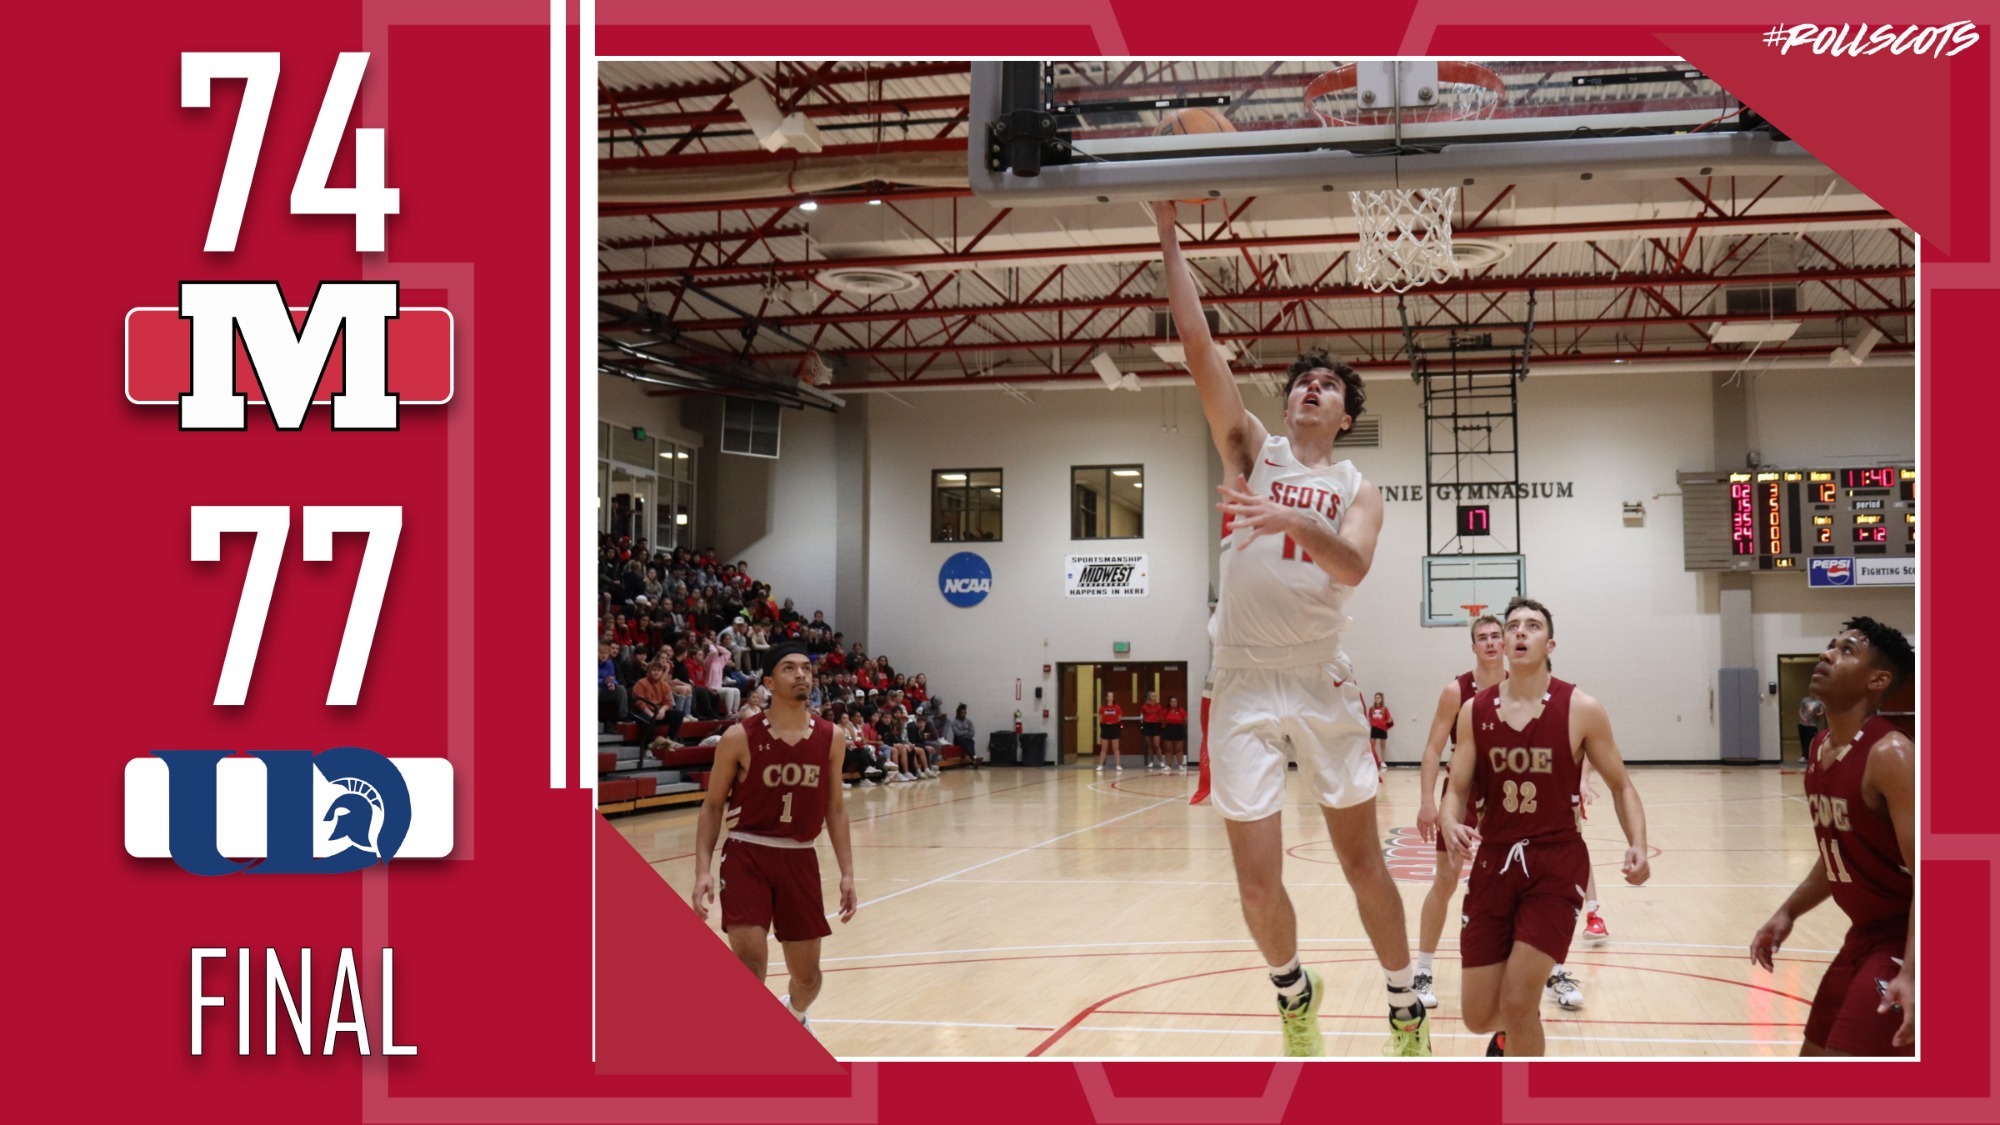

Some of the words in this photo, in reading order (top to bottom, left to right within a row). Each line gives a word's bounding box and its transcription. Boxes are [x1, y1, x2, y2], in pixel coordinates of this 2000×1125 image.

[1849, 468, 1895, 488] 11:40
[1436, 482, 1574, 500] GYMNASIUM
[1732, 484, 1751, 498] 02
[1769, 483, 1778, 498] 3
[1820, 483, 1836, 502] 12
[1269, 481, 1341, 521] SCOTS
[1738, 498, 1751, 512] 15
[1769, 498, 1779, 512] 5
[1856, 500, 1880, 510] period
[1468, 509, 1488, 530] 17
[1734, 513, 1752, 527] 35
[1770, 512, 1779, 526] 0
[1733, 527, 1752, 541] 24
[1770, 526, 1780, 540] 0
[1821, 528, 1830, 542] 2
[1740, 541, 1753, 554] 11
[1771, 540, 1780, 554] 0
[1812, 559, 1851, 569] PEPSI
[1079, 566, 1135, 583] MIDWEST
[944, 578, 990, 593] NCAA
[1488, 747, 1553, 774] COE
[762, 763, 820, 788] COE
[1502, 780, 1537, 813] 32
[779, 792, 793, 823] 1
[1808, 793, 1852, 832] COE
[1820, 837, 1852, 883] 11
